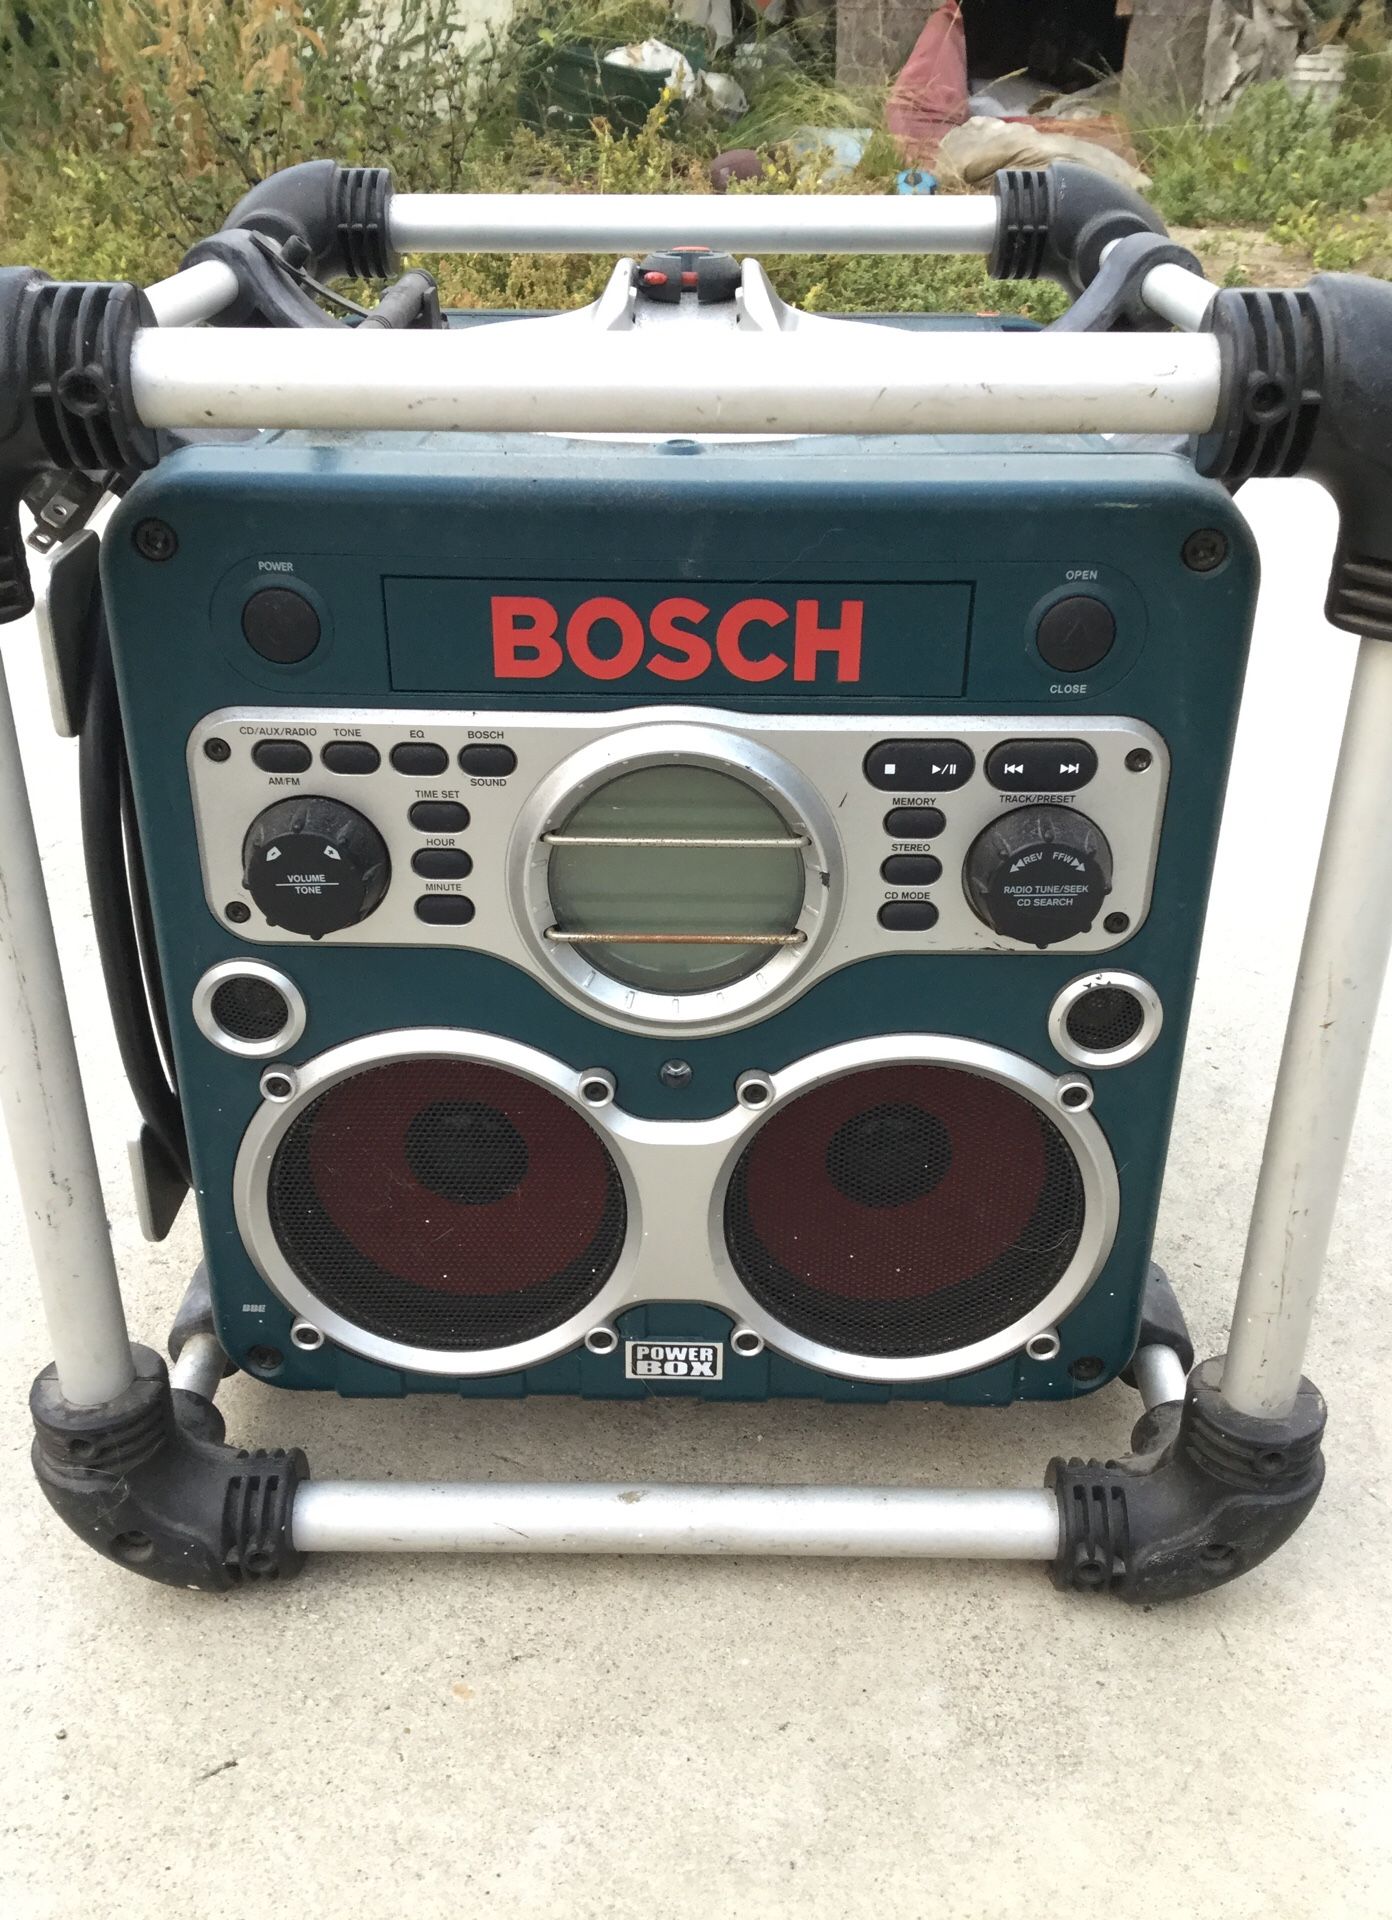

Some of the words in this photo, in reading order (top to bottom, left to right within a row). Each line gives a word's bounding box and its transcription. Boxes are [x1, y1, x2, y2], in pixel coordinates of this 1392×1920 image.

[258, 561, 294, 572] POWER
[1065, 570, 1098, 580] OPEN
[490, 595, 864, 683] BOSCH
[1049, 684, 1087, 695] CLOSE
[239, 726, 317, 737] CD/AUX/RADIO
[333, 728, 362, 737] TONE
[409, 730, 425, 739] EQ
[467, 730, 504, 739] BOSCH
[268, 777, 300, 786] AM/FM
[470, 778, 507, 787] SOUND
[415, 790, 438, 798] TIME
[441, 790, 460, 799] SET
[892, 797, 937, 807] MEMORY
[999, 795, 1076, 804] TRACK/PRESET
[426, 838, 455, 847] HOUR
[891, 843, 931, 852] STEREO
[1023, 851, 1043, 865] REV
[1052, 851, 1073, 864] FFW
[287, 874, 326, 883] VOLUME
[294, 886, 322, 894] TONE
[425, 883, 462, 892] MINUTE
[1003, 885, 1032, 894] RADIO
[1035, 885, 1089, 893] TUNE/SEEK
[884, 891, 899, 900] CD
[901, 891, 930, 900] MODE
[1016, 898, 1031, 907] CD
[1033, 898, 1073, 906] SEARCH
[636, 1346, 714, 1361] POWER
[636, 1360, 714, 1376] BOX
